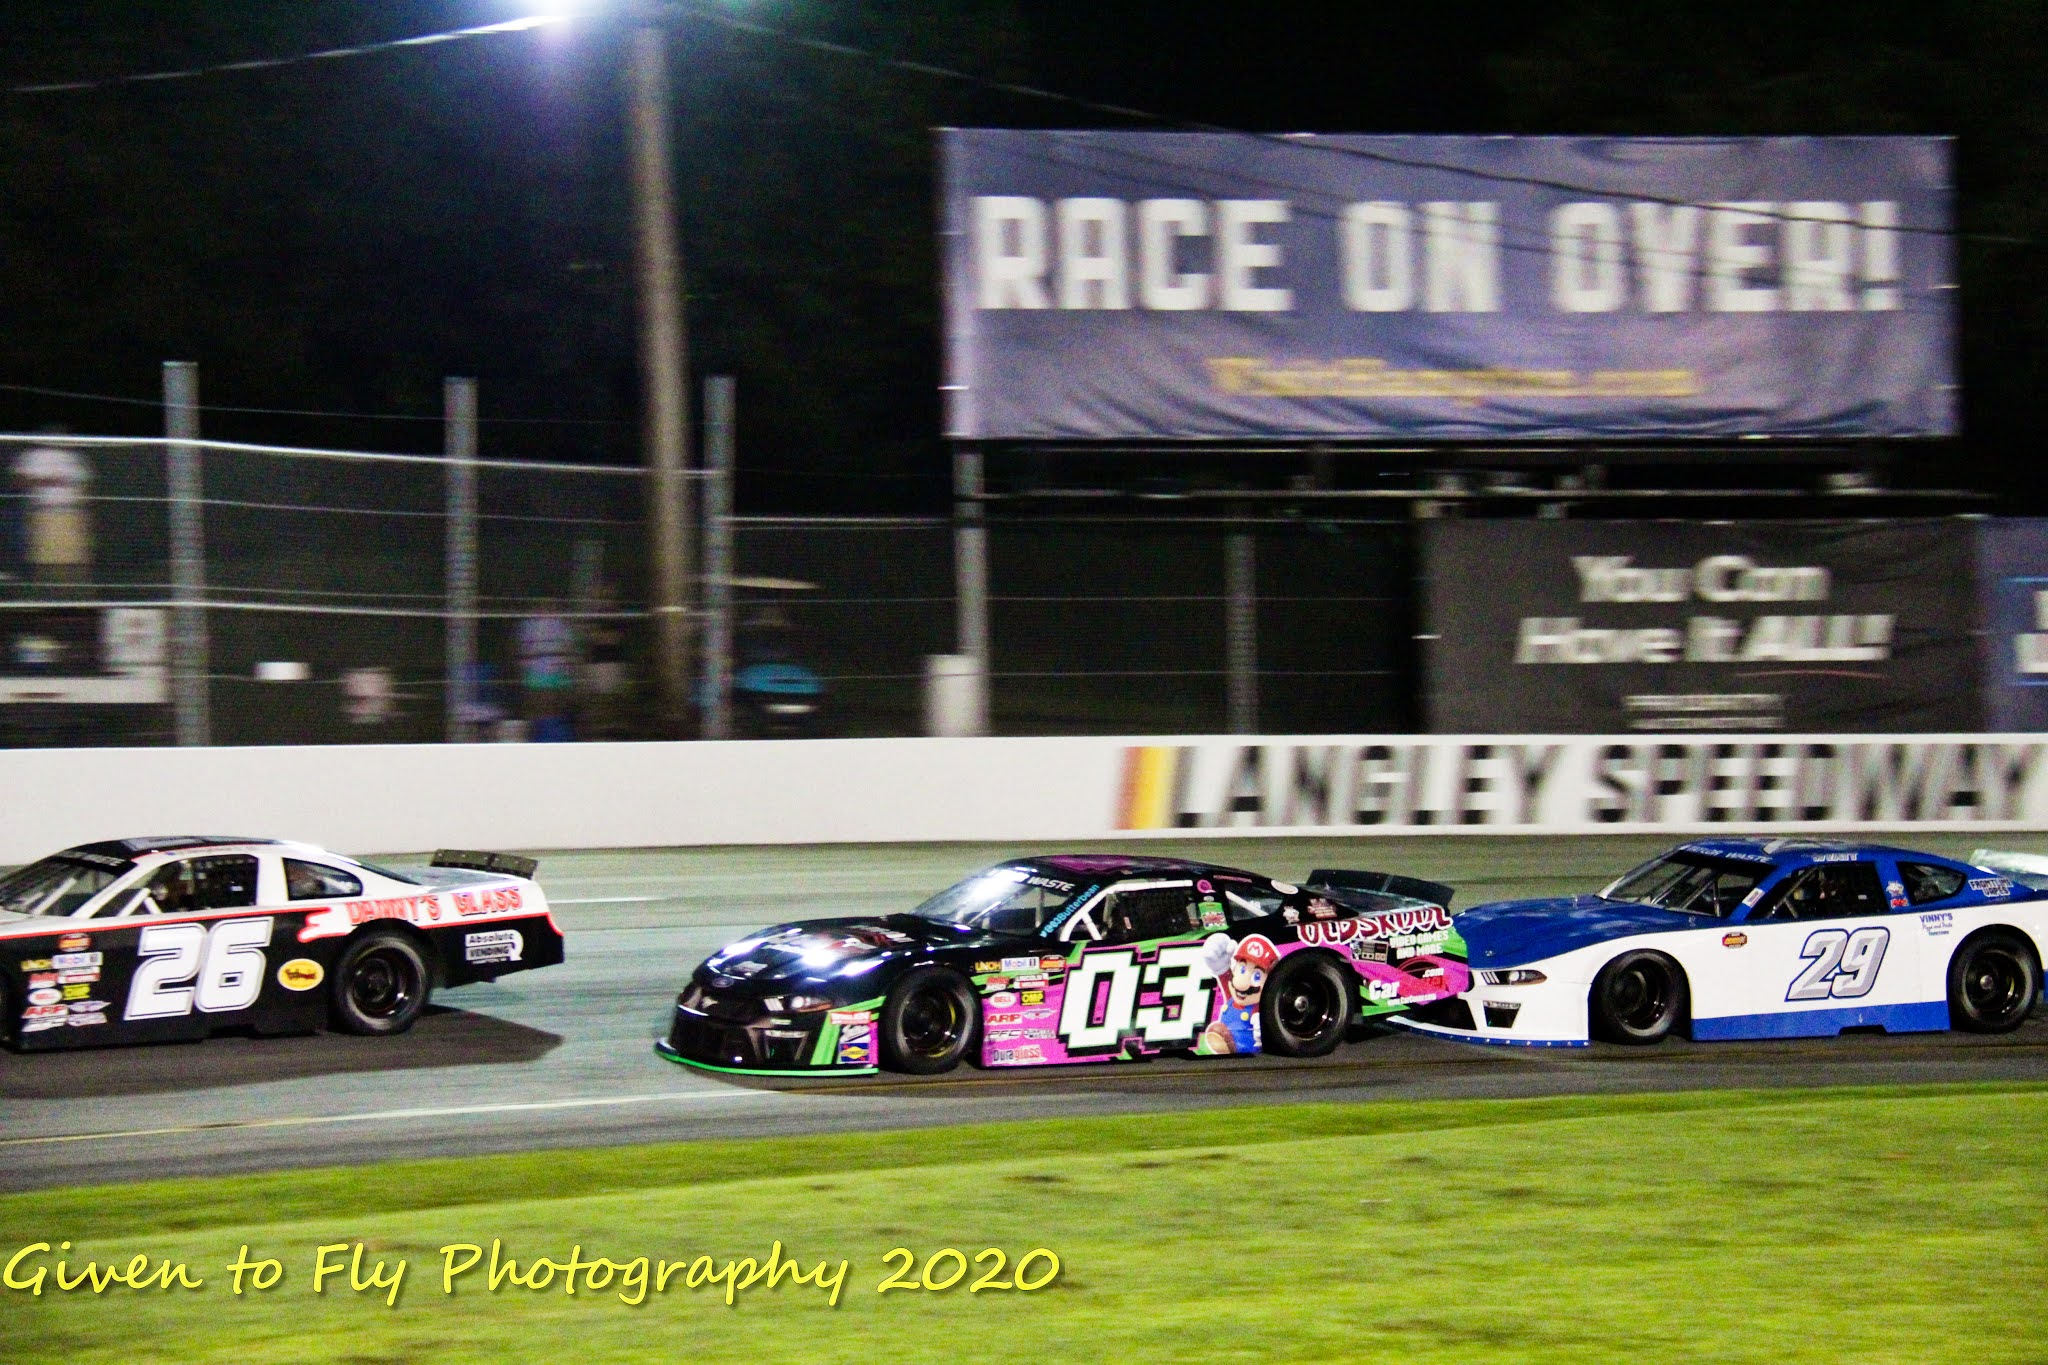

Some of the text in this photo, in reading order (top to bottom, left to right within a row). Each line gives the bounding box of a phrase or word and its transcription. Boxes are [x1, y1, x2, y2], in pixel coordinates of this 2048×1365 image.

[973, 195, 1902, 313] RACE ON OVER!
[1571, 554, 1830, 603] You Can
[1513, 617, 1680, 665] Have
[1172, 743, 2047, 829] LANGLEY SPEEDWAY
[1027, 877, 1075, 892] WASTE
[345, 885, 524, 926] DANNY'S GLASS
[1920, 913, 1953, 923] VINNY'S
[469, 931, 516, 944] Absolute
[1389, 929, 1449, 949] VIDEO GAMES
[469, 944, 511, 957] VENDING
[123, 916, 275, 1021] 26
[1004, 959, 1027, 968] Mobil
[1786, 926, 1891, 1002] 29
[994, 995, 1012, 1003] BELL
[1021, 993, 1043, 1003] OMP
[1058, 946, 1213, 1050] 03
[1369, 979, 1400, 1001] Car
[986, 1013, 1021, 1023] ARP
[993, 1047, 1040, 1061] Duragloss
